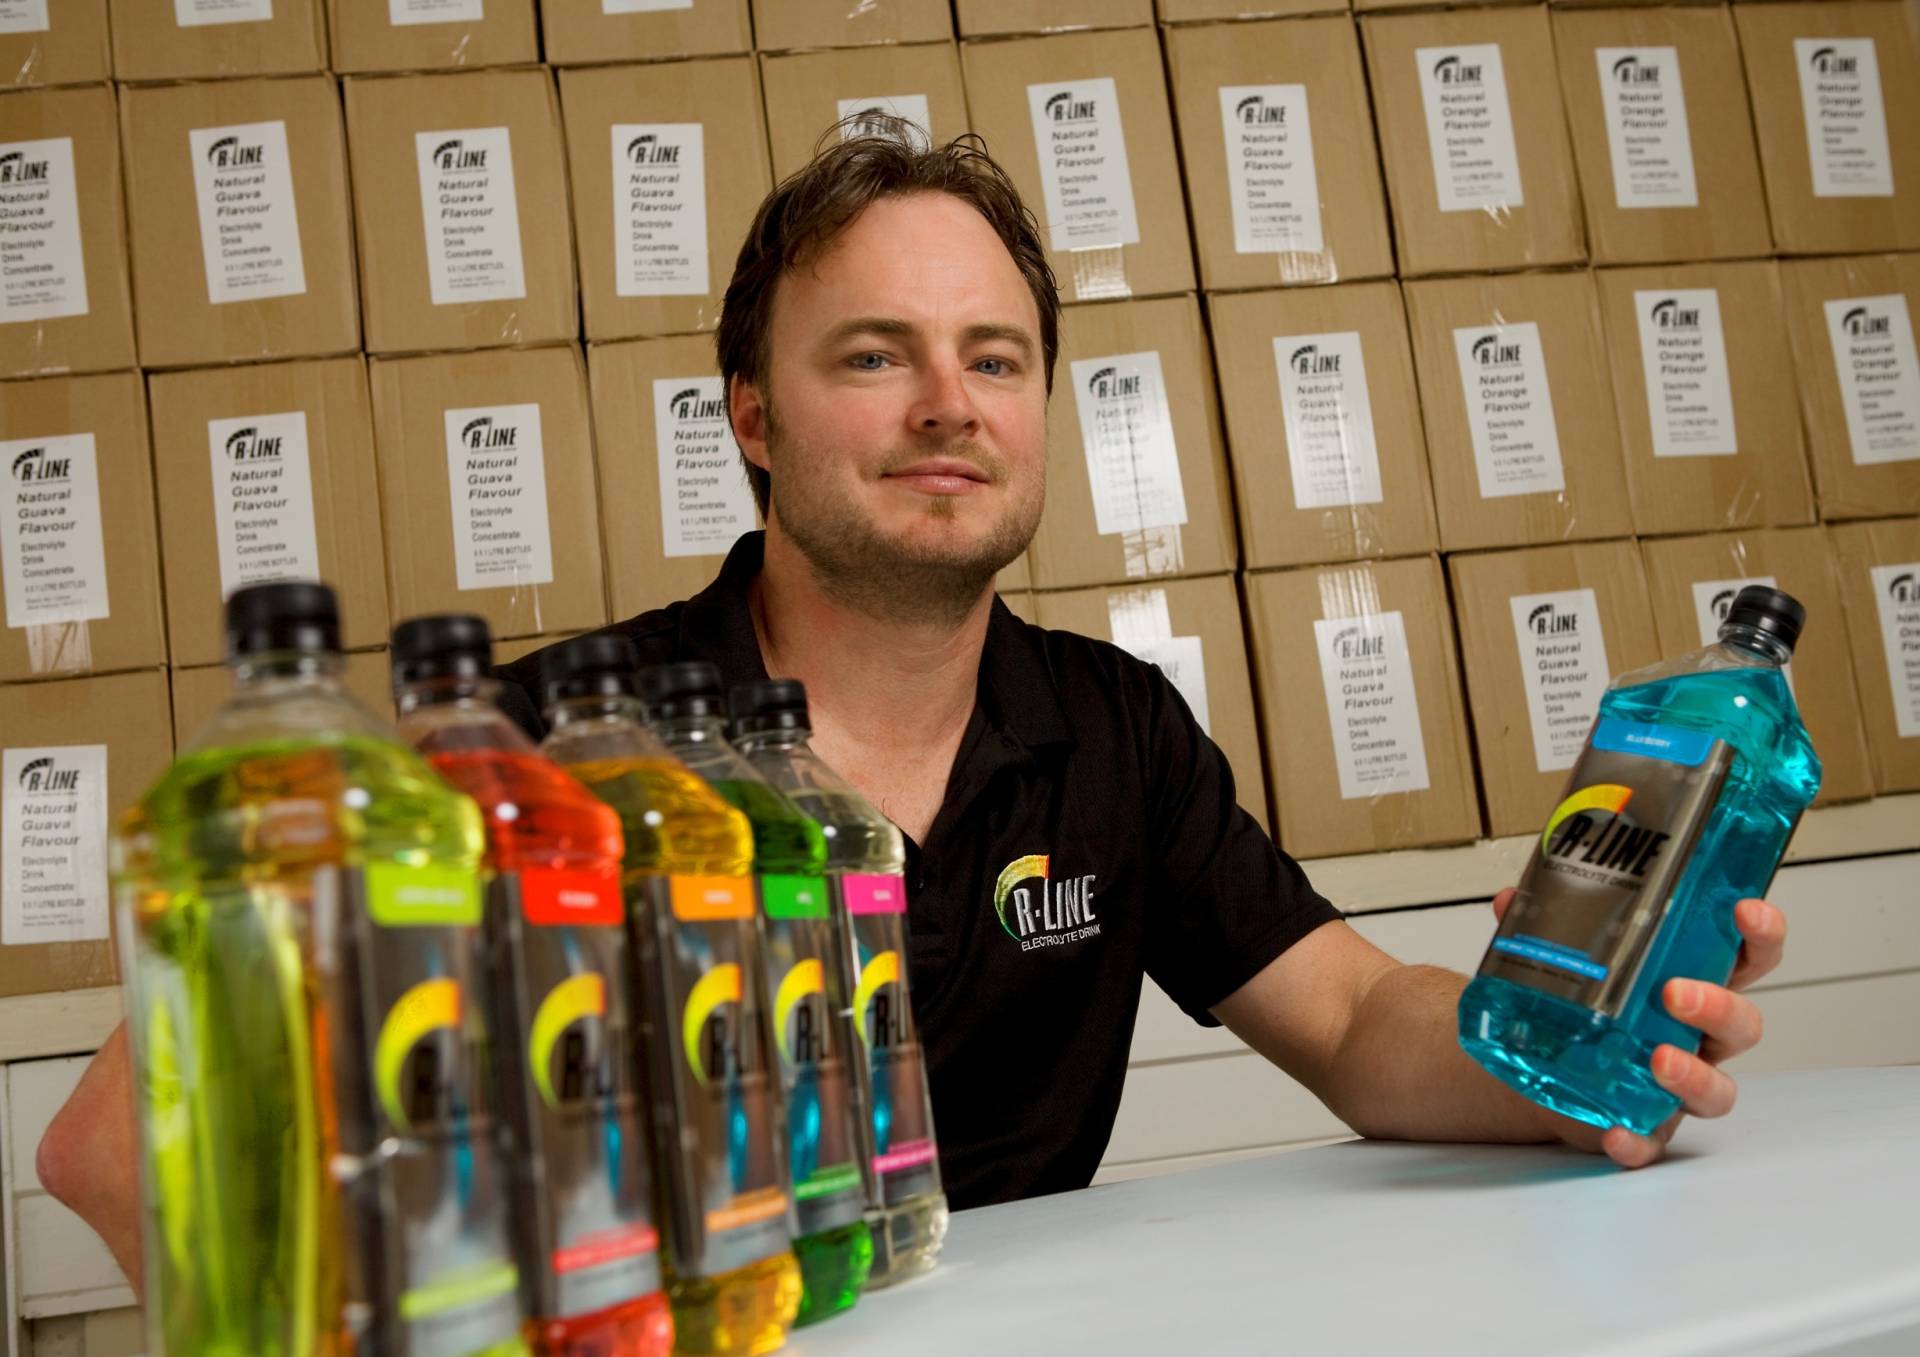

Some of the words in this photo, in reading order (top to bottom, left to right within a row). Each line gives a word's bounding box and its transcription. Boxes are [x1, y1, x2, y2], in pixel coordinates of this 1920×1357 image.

[1441, 92, 1485, 103] Natural
[1054, 96, 1095, 120] R-LINE
[1244, 100, 1286, 123] R-LINE
[1442, 107, 1487, 116] Orange
[1052, 128, 1097, 141] Natural
[1241, 133, 1287, 143] Natural
[217, 141, 263, 166] R-LINE
[635, 139, 680, 162] R-LINE
[1053, 144, 1094, 154] Guava
[1242, 147, 1283, 156] Guava
[442, 144, 487, 169] R-LINE
[1056, 156, 1104, 168] Flavour
[1, 156, 49, 182] R-LINE
[1244, 161, 1291, 170] Flavour
[214, 174, 264, 188] Natural
[438, 178, 488, 190] Natural
[630, 174, 679, 183] Natural
[215, 190, 260, 202] Guava
[631, 187, 673, 197] Guava
[439, 194, 483, 204] Guava
[217, 203, 270, 216] Flavour
[631, 202, 682, 211] Flavour
[441, 207, 493, 218] Flavour
[221, 235, 242, 244] Drink
[444, 238, 464, 246] Drink
[222, 246, 270, 256] Concentrate
[445, 249, 492, 258] Concentrate
[1658, 337, 1701, 346] Natural
[1299, 349, 1340, 374] R-LINE
[1659, 351, 1704, 361] Orange
[1661, 365, 1706, 374] Flavour
[1098, 371, 1140, 397] R-LINE
[1480, 372, 1524, 385] Natural
[1481, 388, 1527, 398] Orange
[678, 393, 723, 418] R-LINE
[1484, 402, 1530, 413] Flavour
[470, 422, 517, 447] R-LINE
[674, 429, 723, 439] Natural
[234, 432, 282, 459] R-LINE
[675, 444, 718, 454] Guava
[21, 453, 70, 480] R-LINE
[466, 457, 517, 469] Natural
[676, 459, 727, 468] Flavour
[231, 467, 282, 481] Natural
[467, 474, 512, 484] Guava
[17, 488, 71, 503] Natural
[232, 485, 277, 496] Guava
[468, 487, 521, 499] Flavour
[678, 489, 698, 497] Drink
[233, 498, 287, 511] Flavour
[18, 506, 65, 518] Guava
[470, 506, 512, 516] Electrolyte
[19, 520, 76, 533] Flavour
[235, 518, 277, 529] Electrolyte
[471, 520, 492, 529] Drink
[236, 532, 257, 541] Drink
[472, 531, 519, 541] Concentrate
[21, 540, 65, 552] Electrolyte
[236, 543, 285, 554] Concentrate
[21, 554, 44, 564] Drink
[22, 566, 74, 577] Concentrate
[1537, 608, 1577, 634] R-LINE
[1342, 631, 1383, 658] R-LINE
[1536, 642, 1580, 656] Natural
[1538, 659, 1578, 670] Guava
[1340, 665, 1386, 680] Natural
[1541, 672, 1587, 684] Flavour
[1342, 682, 1383, 694] Guava
[1345, 696, 1393, 709] Flavour
[1546, 704, 1564, 713] Drink
[1548, 715, 1590, 725] Concentrate
[1349, 729, 1369, 738] Drink
[1351, 739, 1395, 750] Concentrate
[27, 763, 80, 790] R-LINE
[21, 802, 77, 814] Natural
[22, 819, 70, 830] Guava
[21, 835, 80, 846] Flavour
[1551, 813, 1670, 876] R-LINE
[21, 869, 44, 879] Drink
[21, 883, 74, 892] Concentrate
[1013, 874, 1096, 937] R-LINE
[1021, 931, 1078, 951] ELECTROLYTE
[1078, 924, 1101, 940] DRINK
